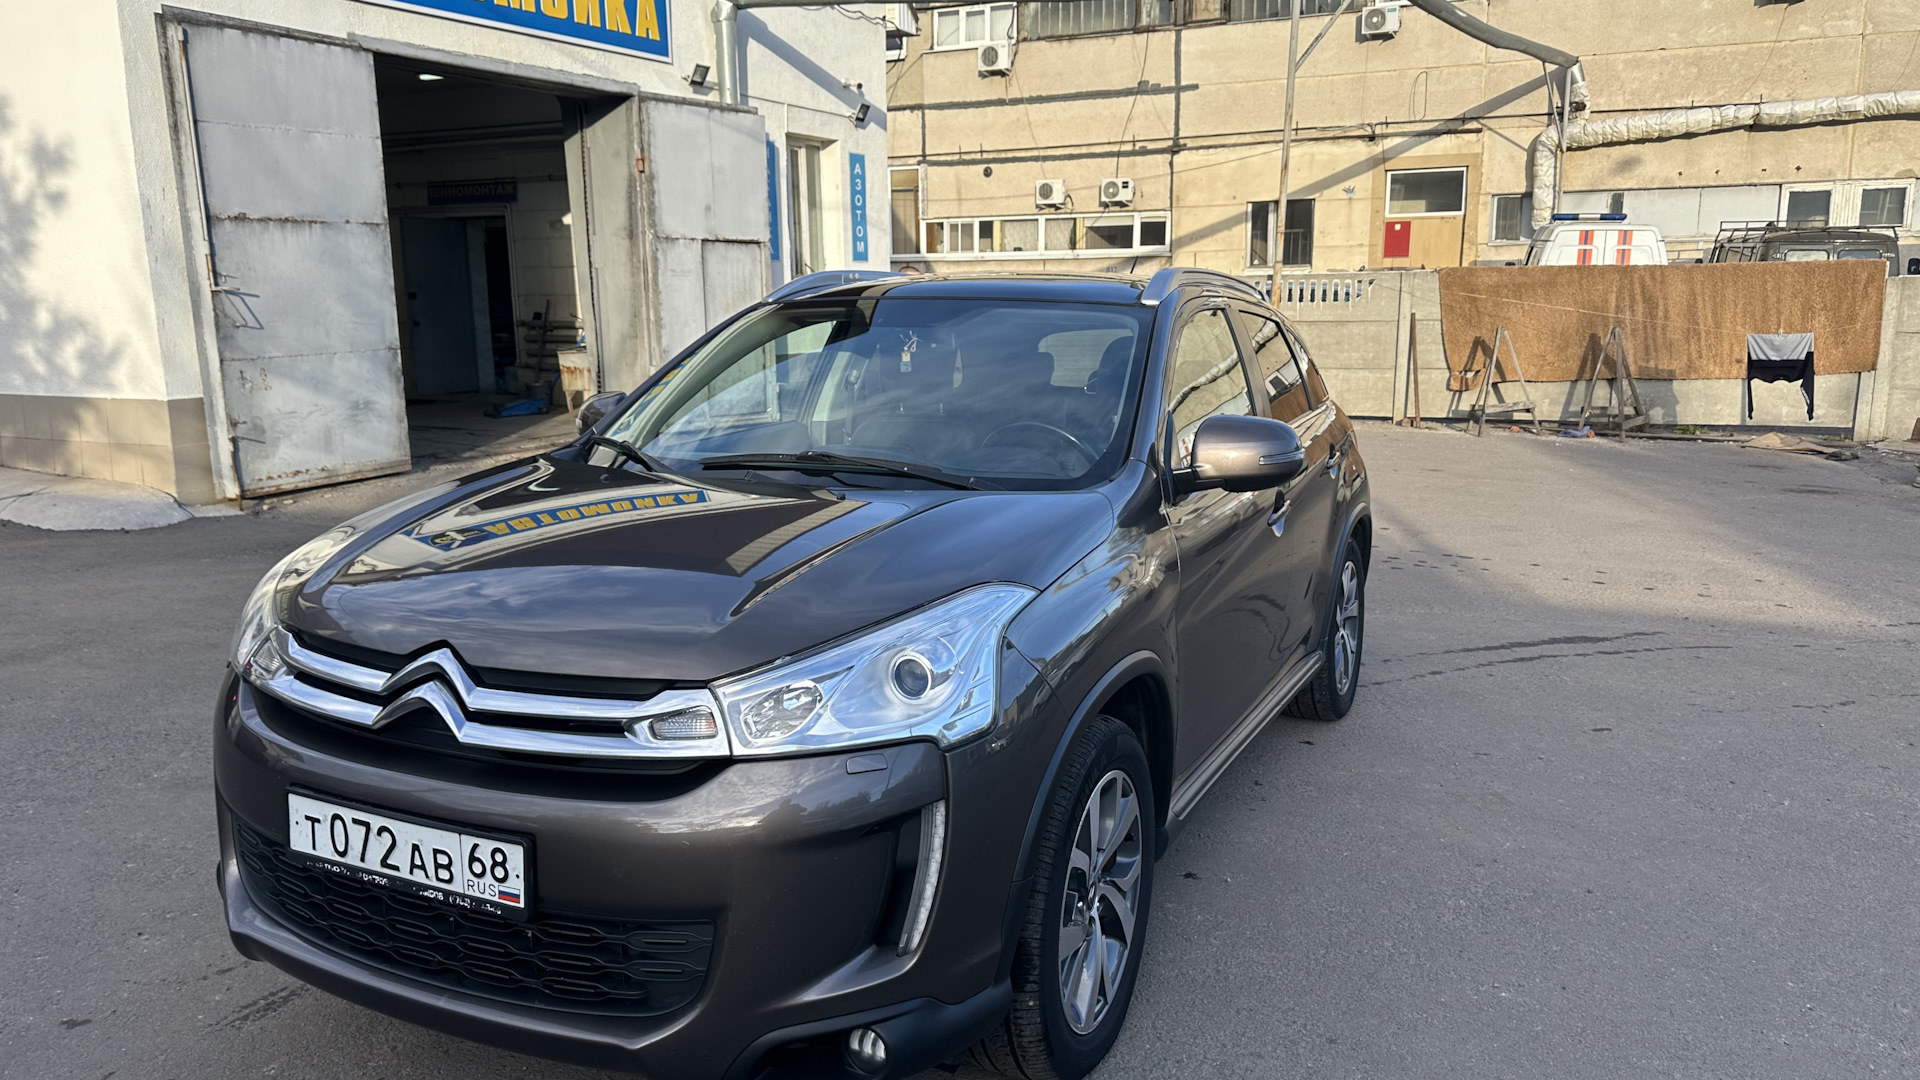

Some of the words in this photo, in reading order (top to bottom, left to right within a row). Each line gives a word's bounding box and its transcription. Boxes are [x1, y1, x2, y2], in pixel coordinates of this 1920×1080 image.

[428, 183, 515, 198] ШИНОМОНТАЖ
[853, 163, 865, 253] АЗОТОМ
[467, 842, 510, 883] 68
[467, 879, 497, 898] RUS
